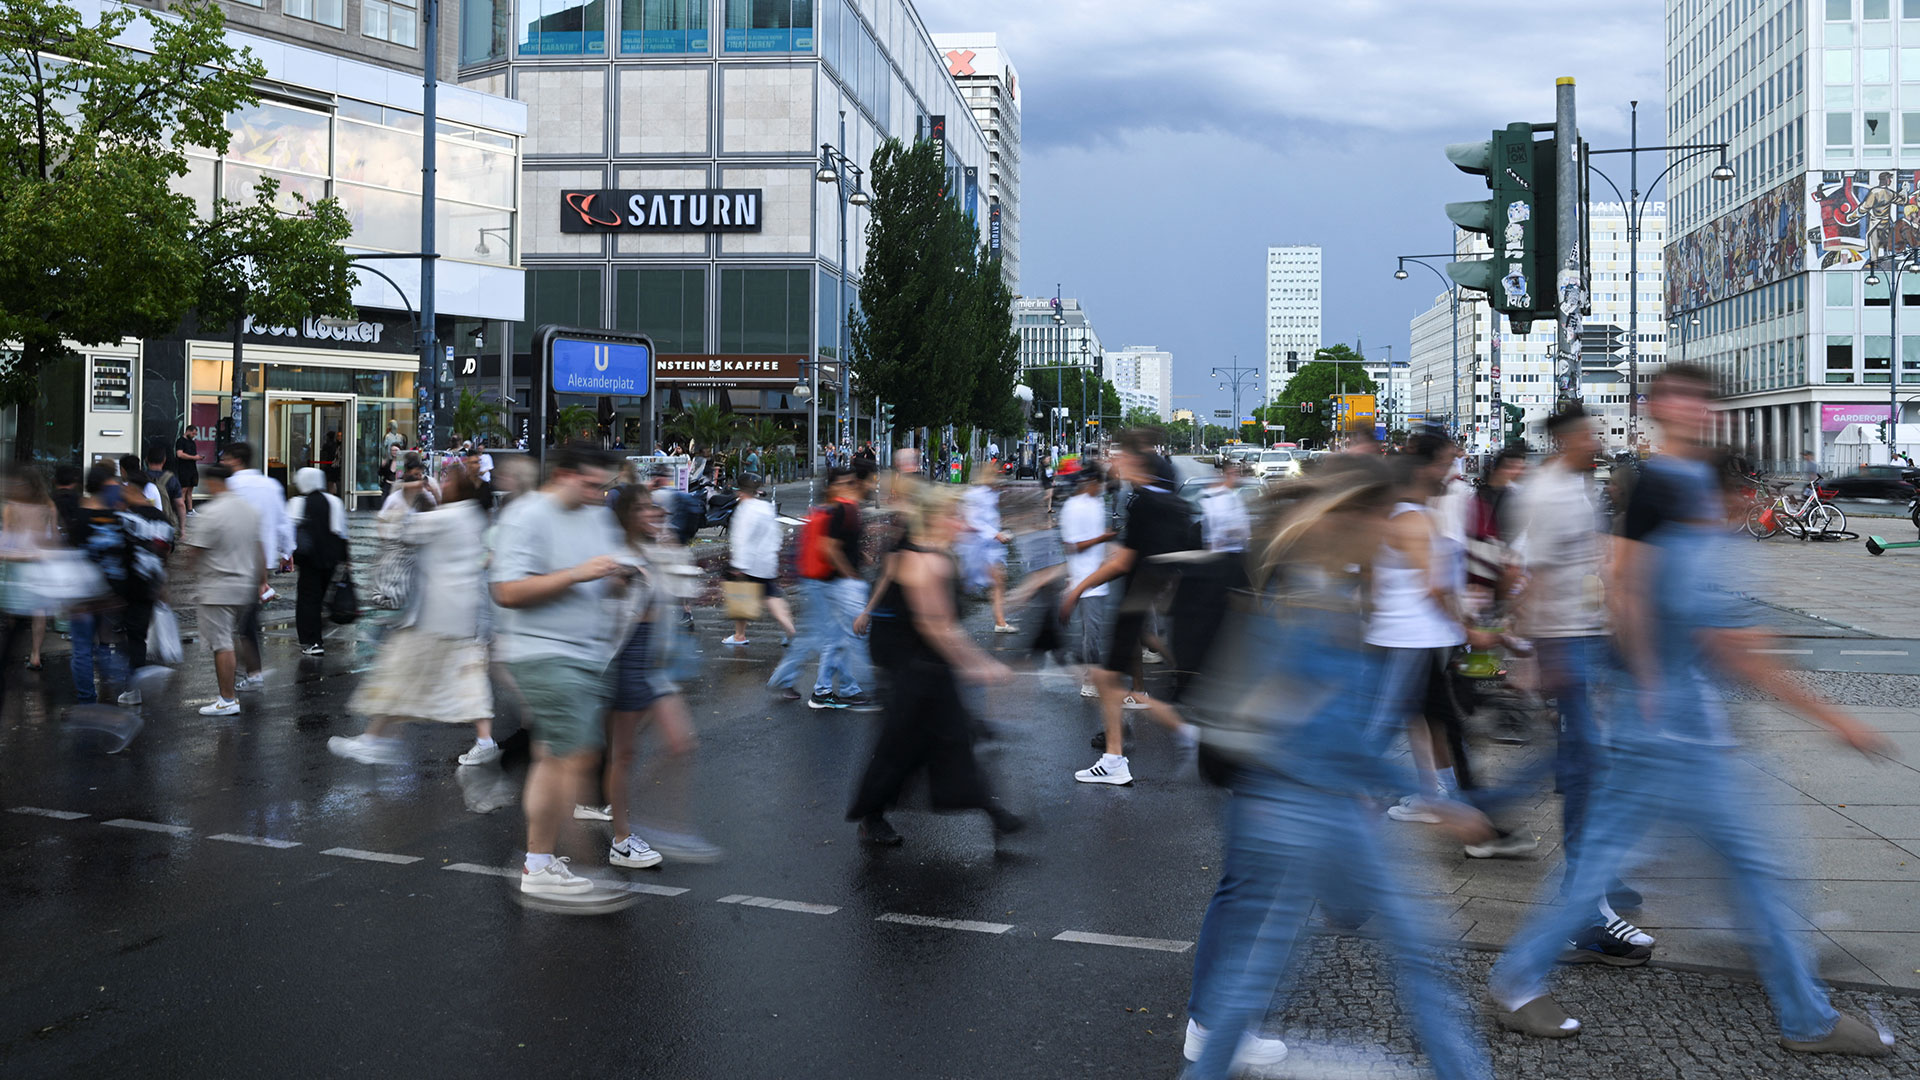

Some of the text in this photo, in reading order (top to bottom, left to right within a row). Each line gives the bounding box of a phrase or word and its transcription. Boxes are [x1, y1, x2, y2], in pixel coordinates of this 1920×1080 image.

[628, 194, 756, 226] SATURN
[1019, 298, 1049, 308] mier Inn
[462, 357, 477, 375] JD
[594, 345, 609, 371] U
[657, 361, 779, 370] NSTEIN KAFFEE
[568, 373, 635, 392] Alexanderplatz
[193, 426, 217, 441] ALE
